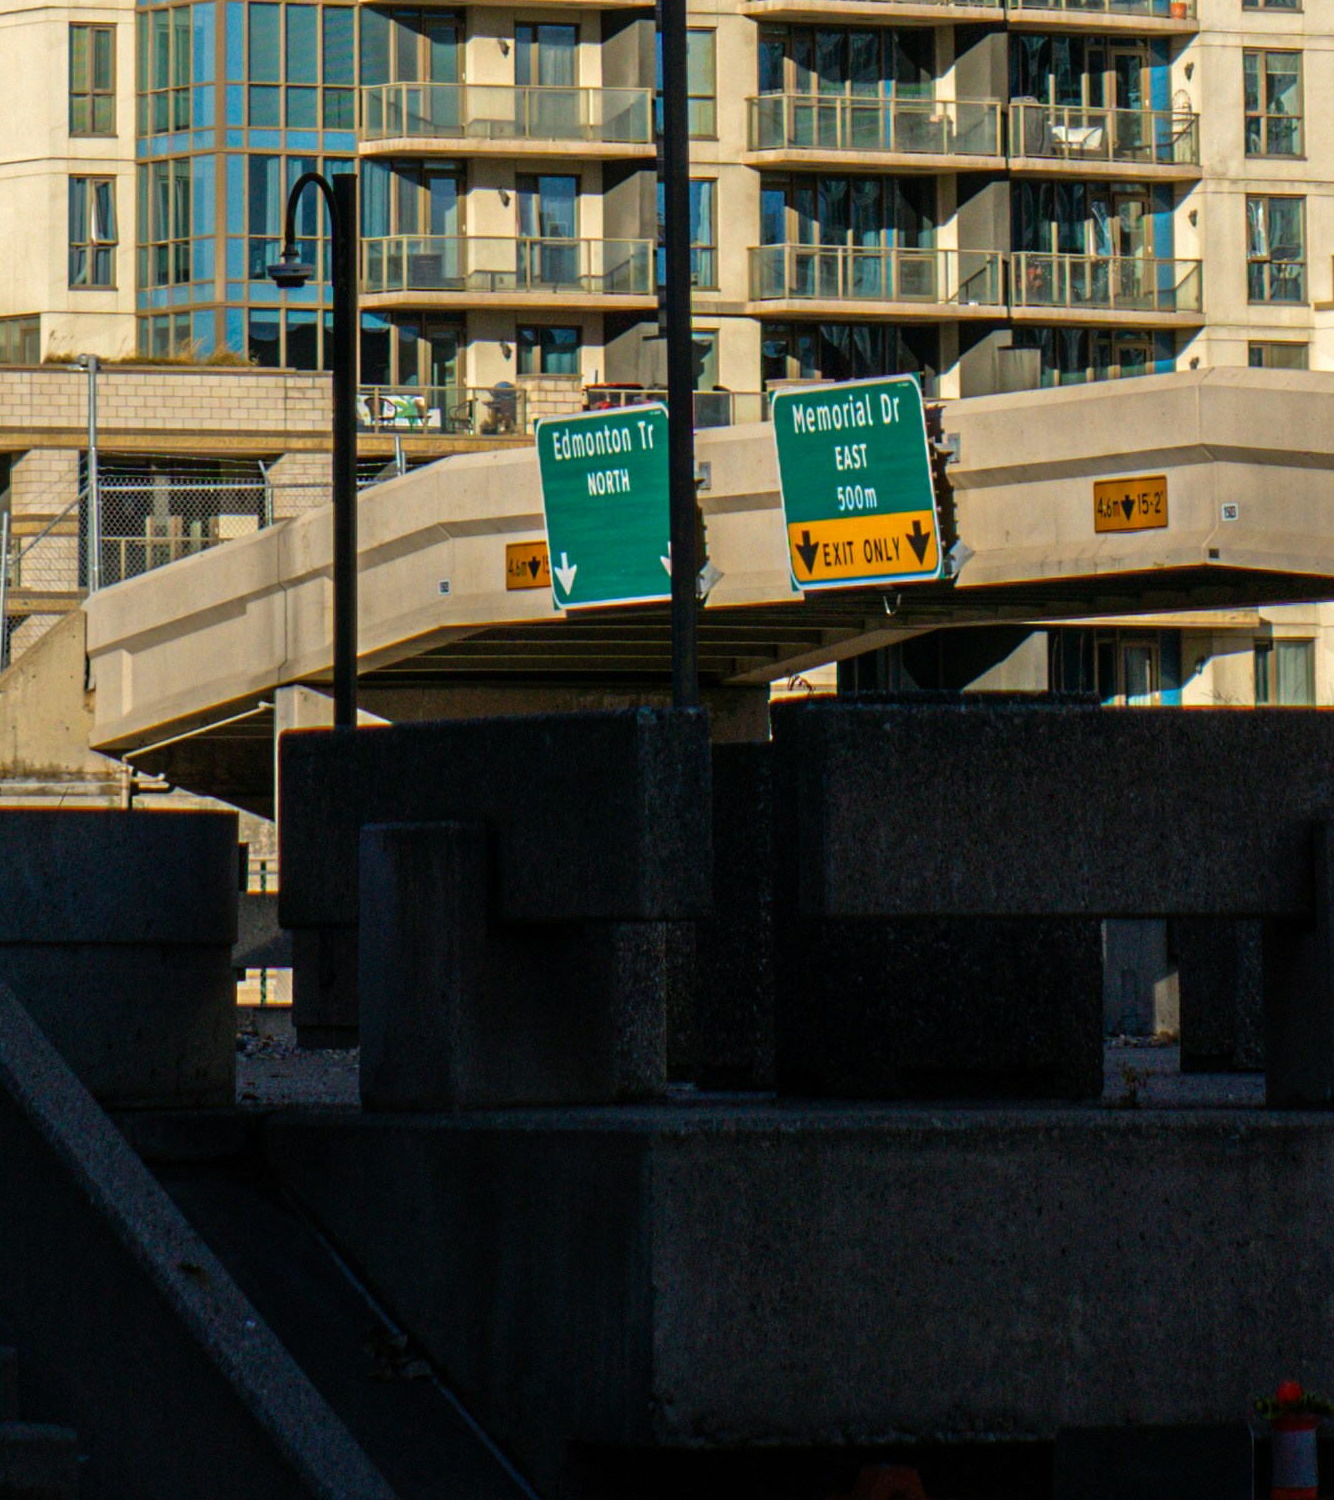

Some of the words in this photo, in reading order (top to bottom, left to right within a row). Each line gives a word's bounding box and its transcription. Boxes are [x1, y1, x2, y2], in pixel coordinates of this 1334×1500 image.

[792, 392, 873, 434] Memorial
[880, 392, 900, 425] Dr
[552, 424, 632, 461] Edmonton
[637, 420, 654, 450] Tr
[834, 443, 867, 471] EAST
[587, 468, 630, 496] NORTH
[837, 484, 877, 511] 500m
[1097, 496, 1121, 518] 4.6m
[823, 540, 854, 567] EXIT
[863, 536, 900, 564] ONLY
